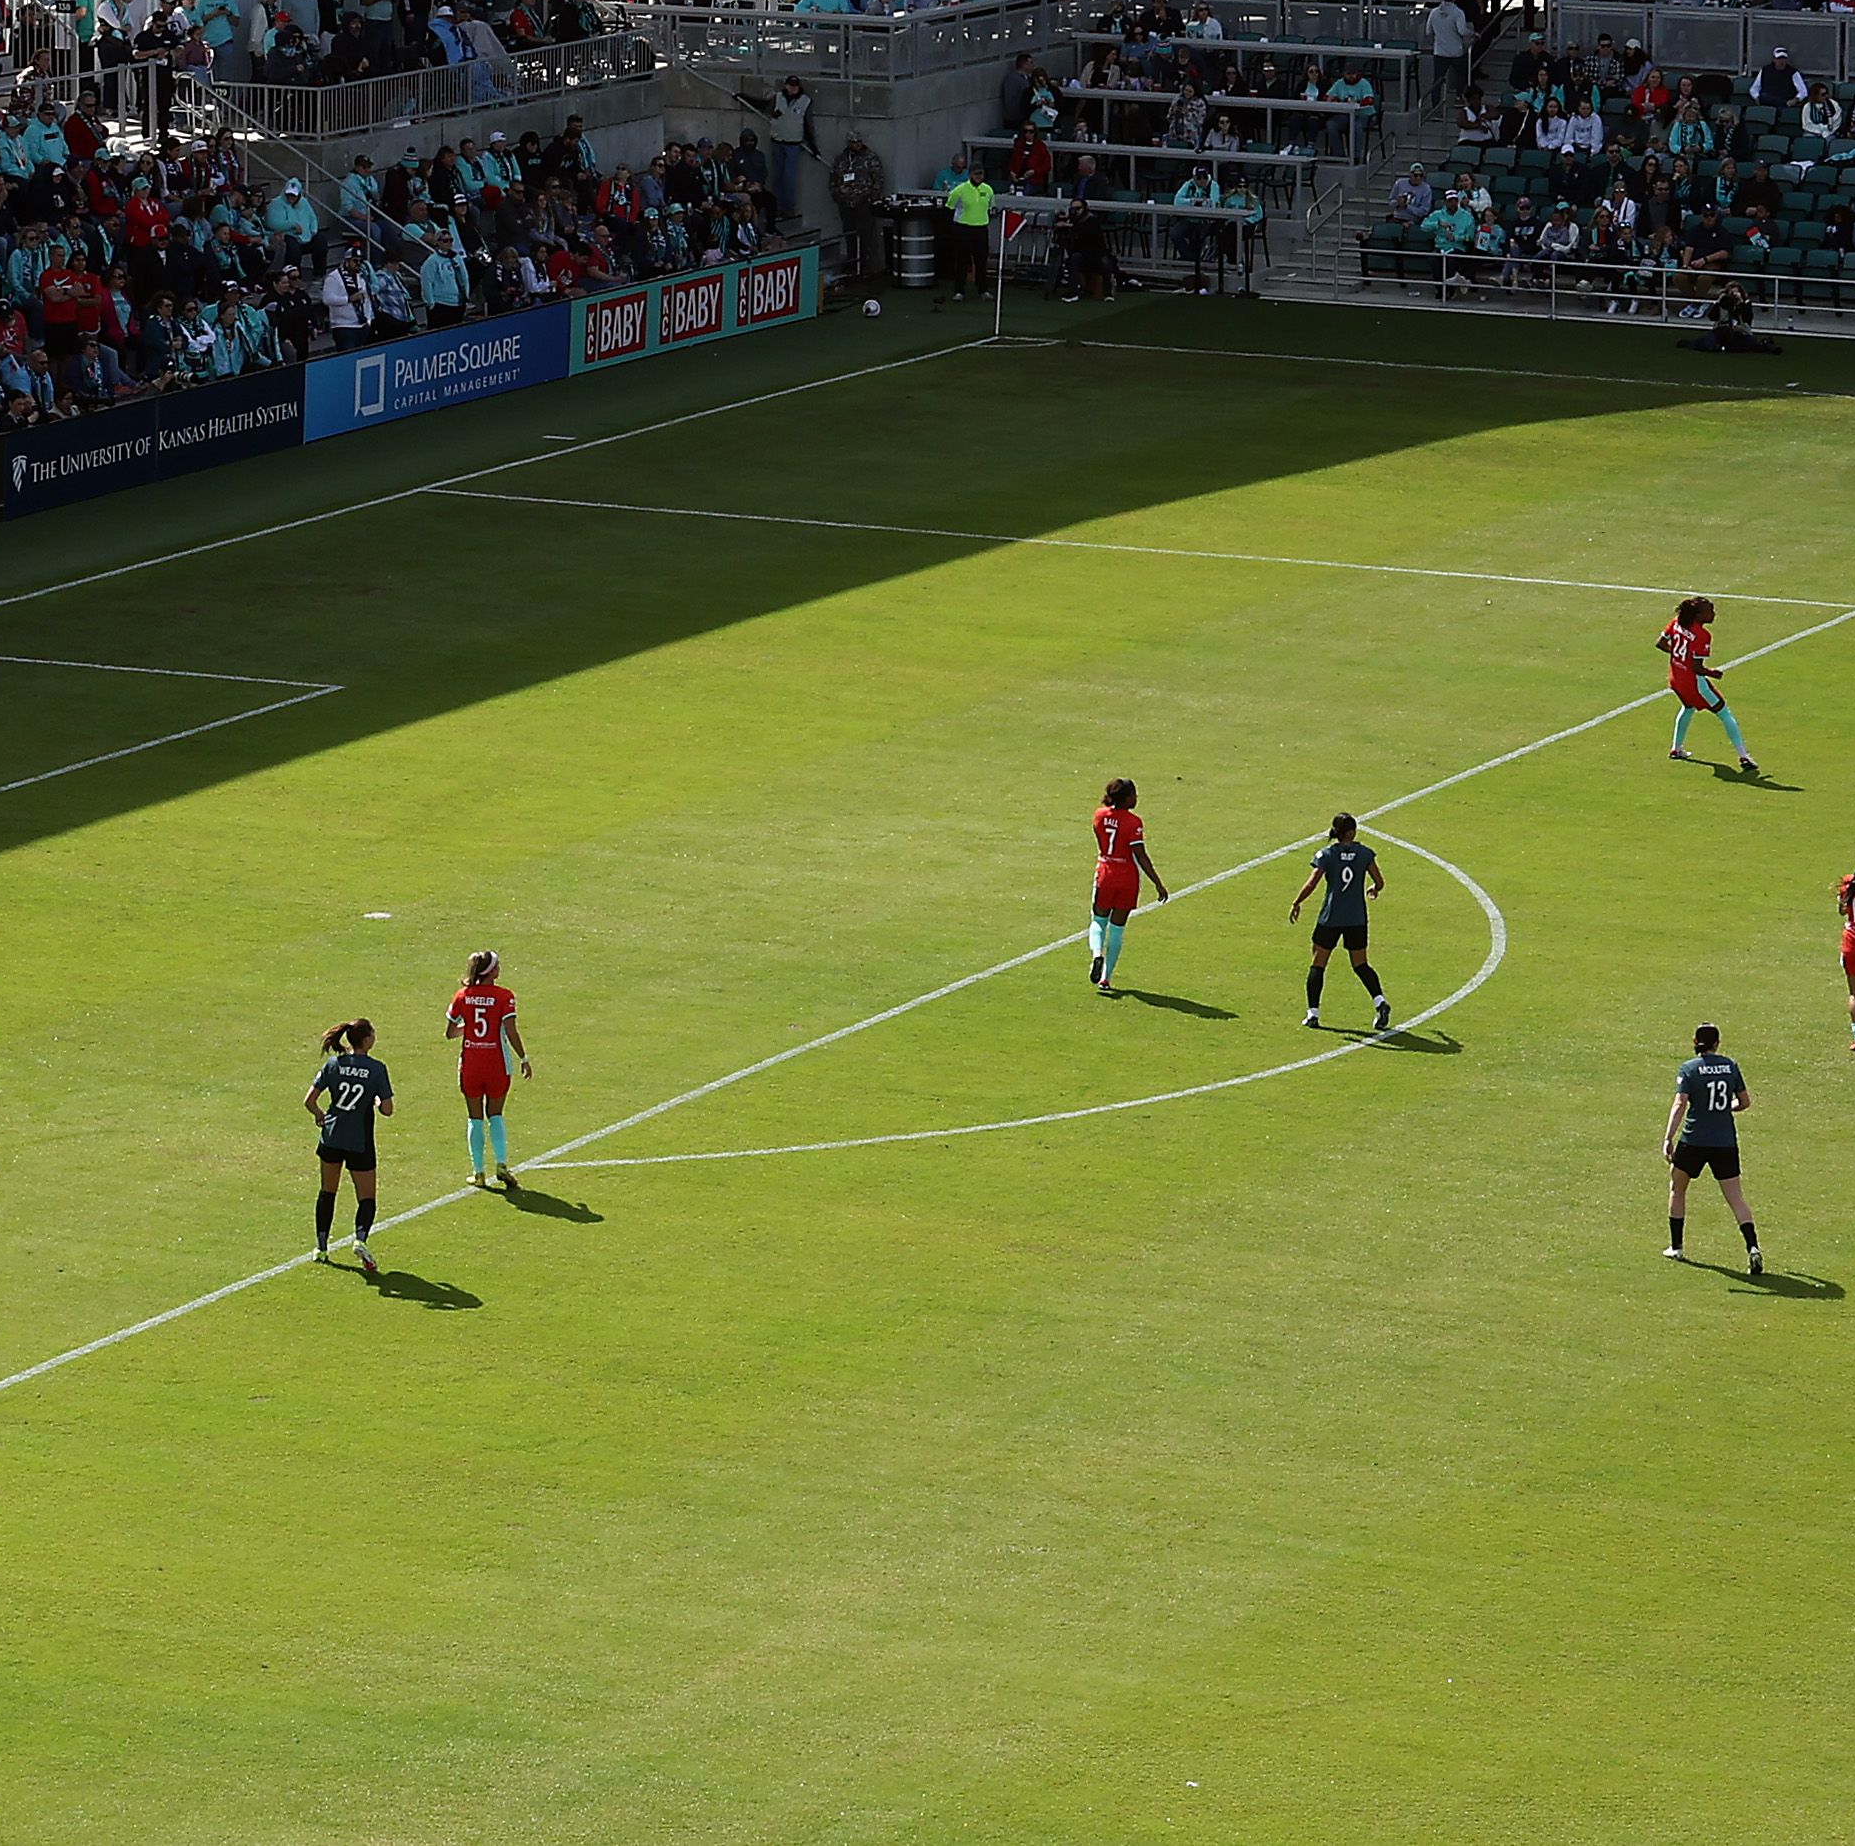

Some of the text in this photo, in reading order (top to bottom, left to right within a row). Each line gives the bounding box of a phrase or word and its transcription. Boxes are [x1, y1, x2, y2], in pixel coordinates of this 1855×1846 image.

[753, 258, 801, 315] BABY
[674, 282, 722, 338] BABY
[599, 299, 647, 353] BABY
[393, 371, 519, 410] CAPITAL MANAGEMENT
[30, 400, 299, 482] THE UNIVERSITY OF KANSAS HEALTH SYSTEM
[1672, 633, 1688, 662] 24
[1103, 818, 1119, 828] BALL
[1105, 829, 1117, 856] 7
[1341, 866, 1354, 892] 9
[465, 996, 496, 1007] WHEELER
[474, 1008, 488, 1039] 5
[339, 1065, 370, 1080] WEAVER
[1698, 1064, 1732, 1075] MOULTRIE
[335, 1082, 365, 1111] 22
[1707, 1080, 1728, 1112] 13
